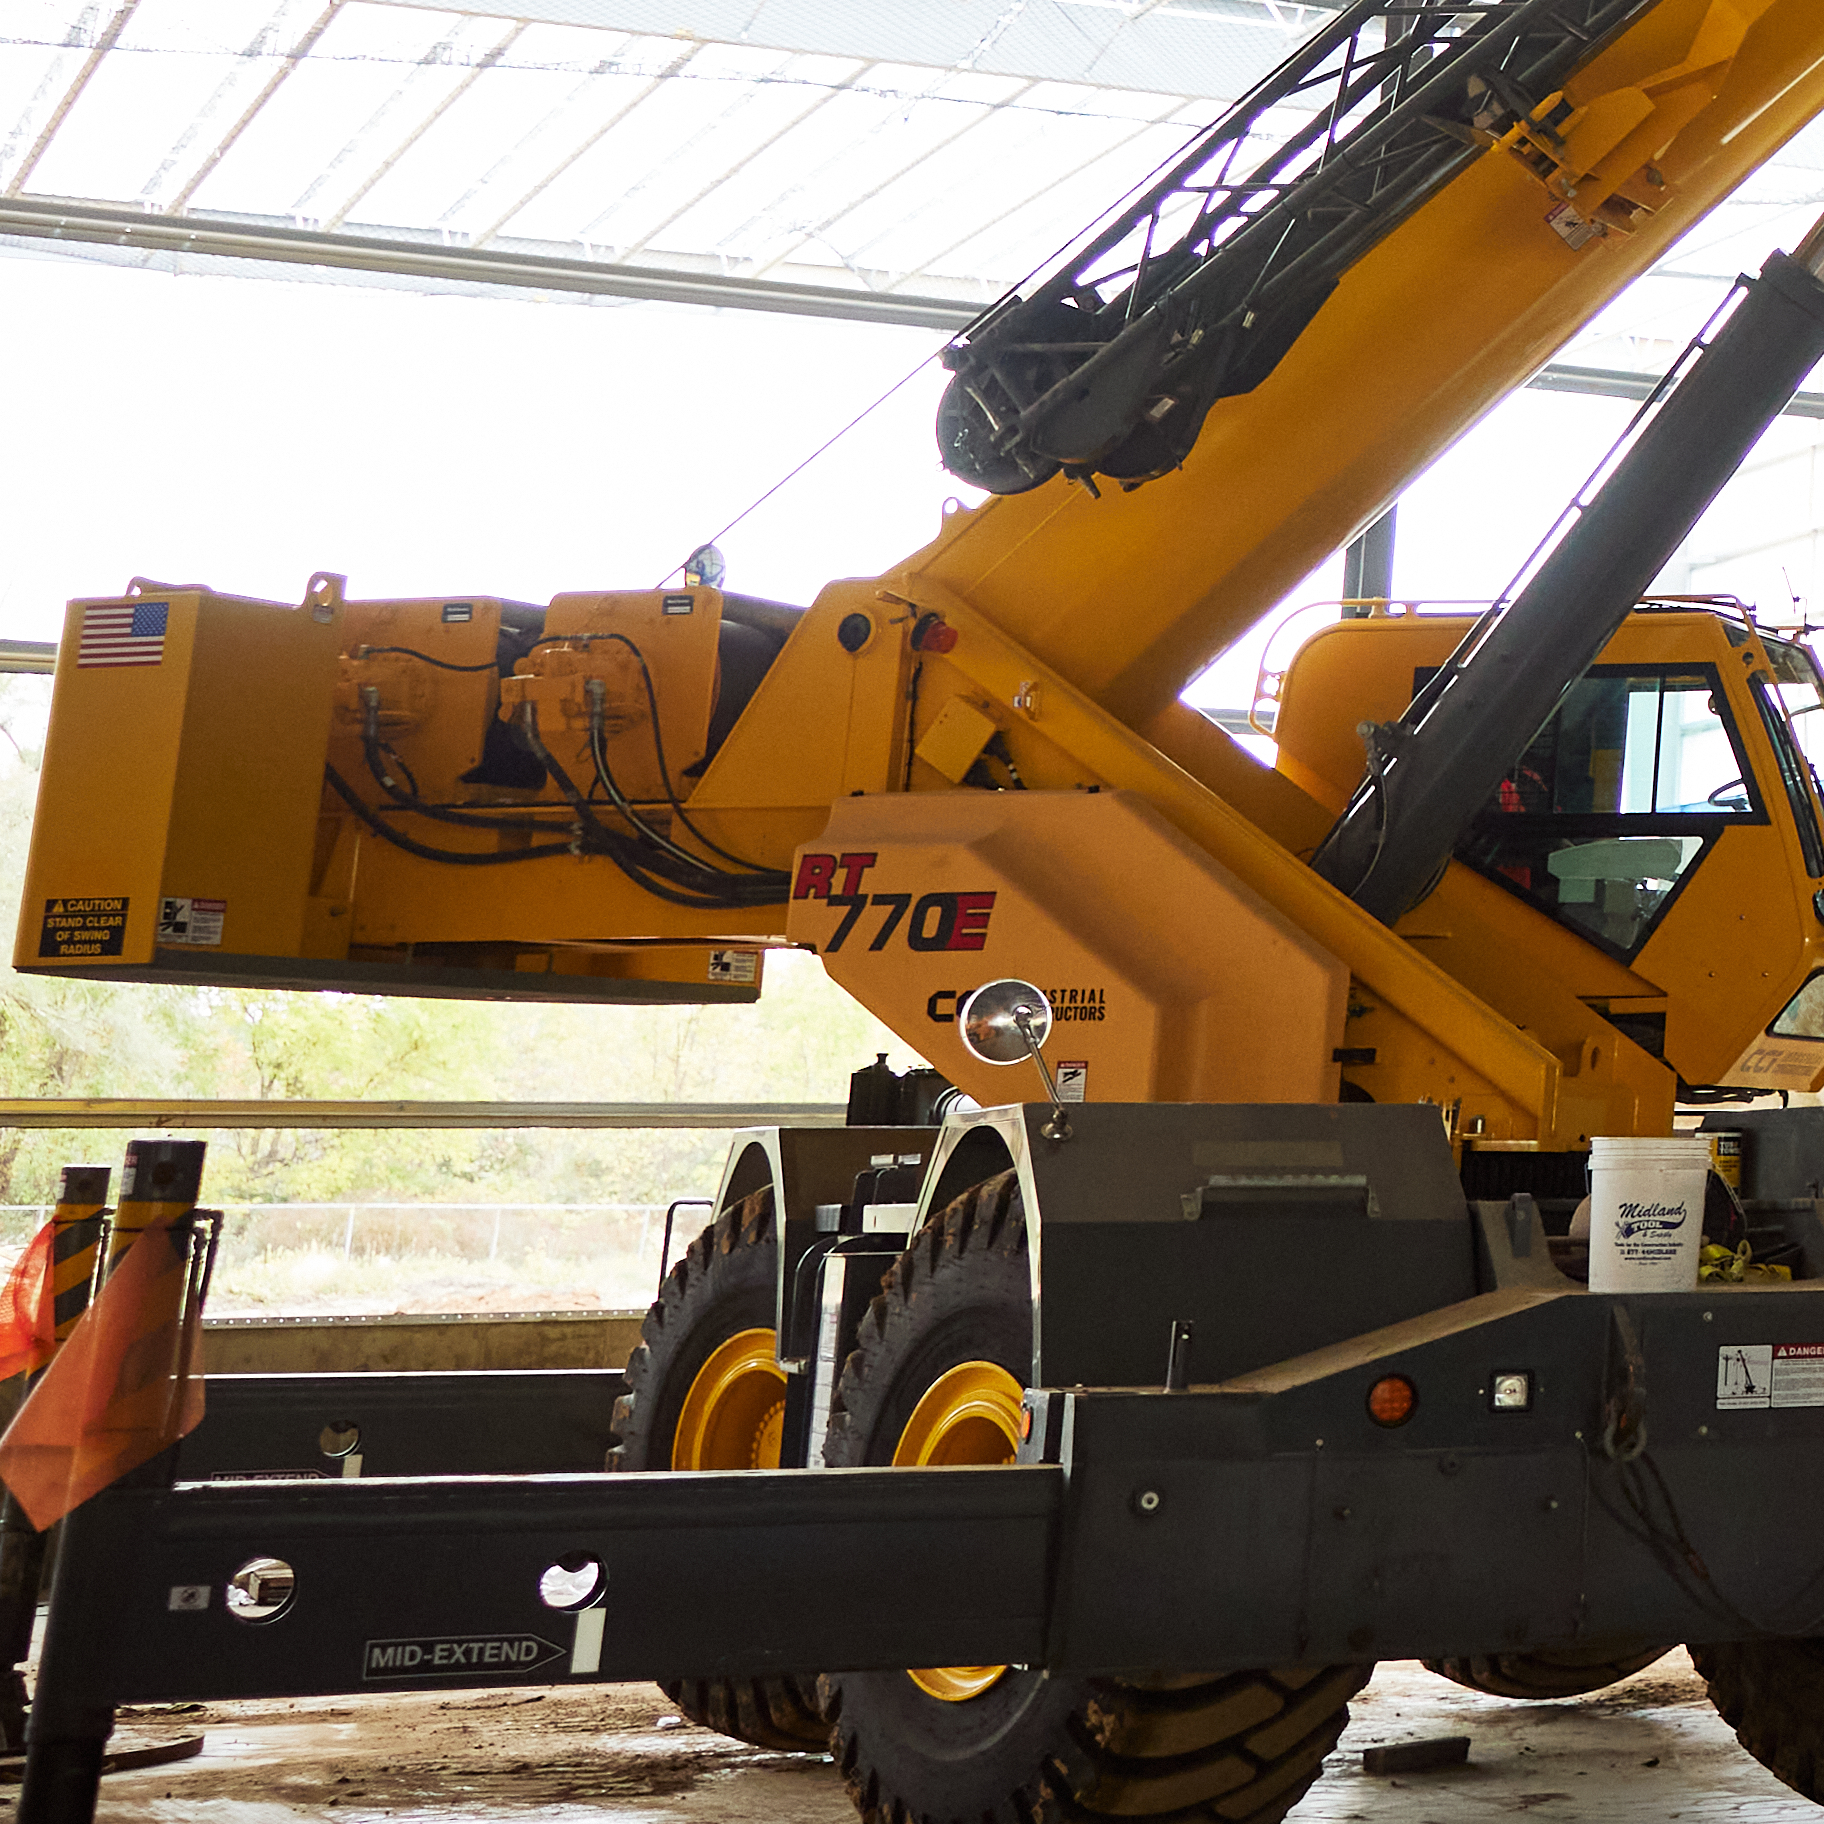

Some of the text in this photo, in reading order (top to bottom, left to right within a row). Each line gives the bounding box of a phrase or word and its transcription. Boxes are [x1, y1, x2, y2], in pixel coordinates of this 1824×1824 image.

[792, 852, 878, 900] RT
[67, 899, 122, 911] CAUTION
[47, 916, 122, 927] STAND CLEAR
[824, 891, 997, 953] 770E
[56, 930, 110, 941] OF SWING
[60, 943, 102, 955] RADIUS
[1043, 989, 1105, 1004] STRIAL
[1051, 1006, 1105, 1021] UCTORS
[1619, 1201, 1684, 1218] Midland
[1631, 1220, 1663, 1231] TOOL
[370, 1640, 539, 1668] MID-EXTEND
